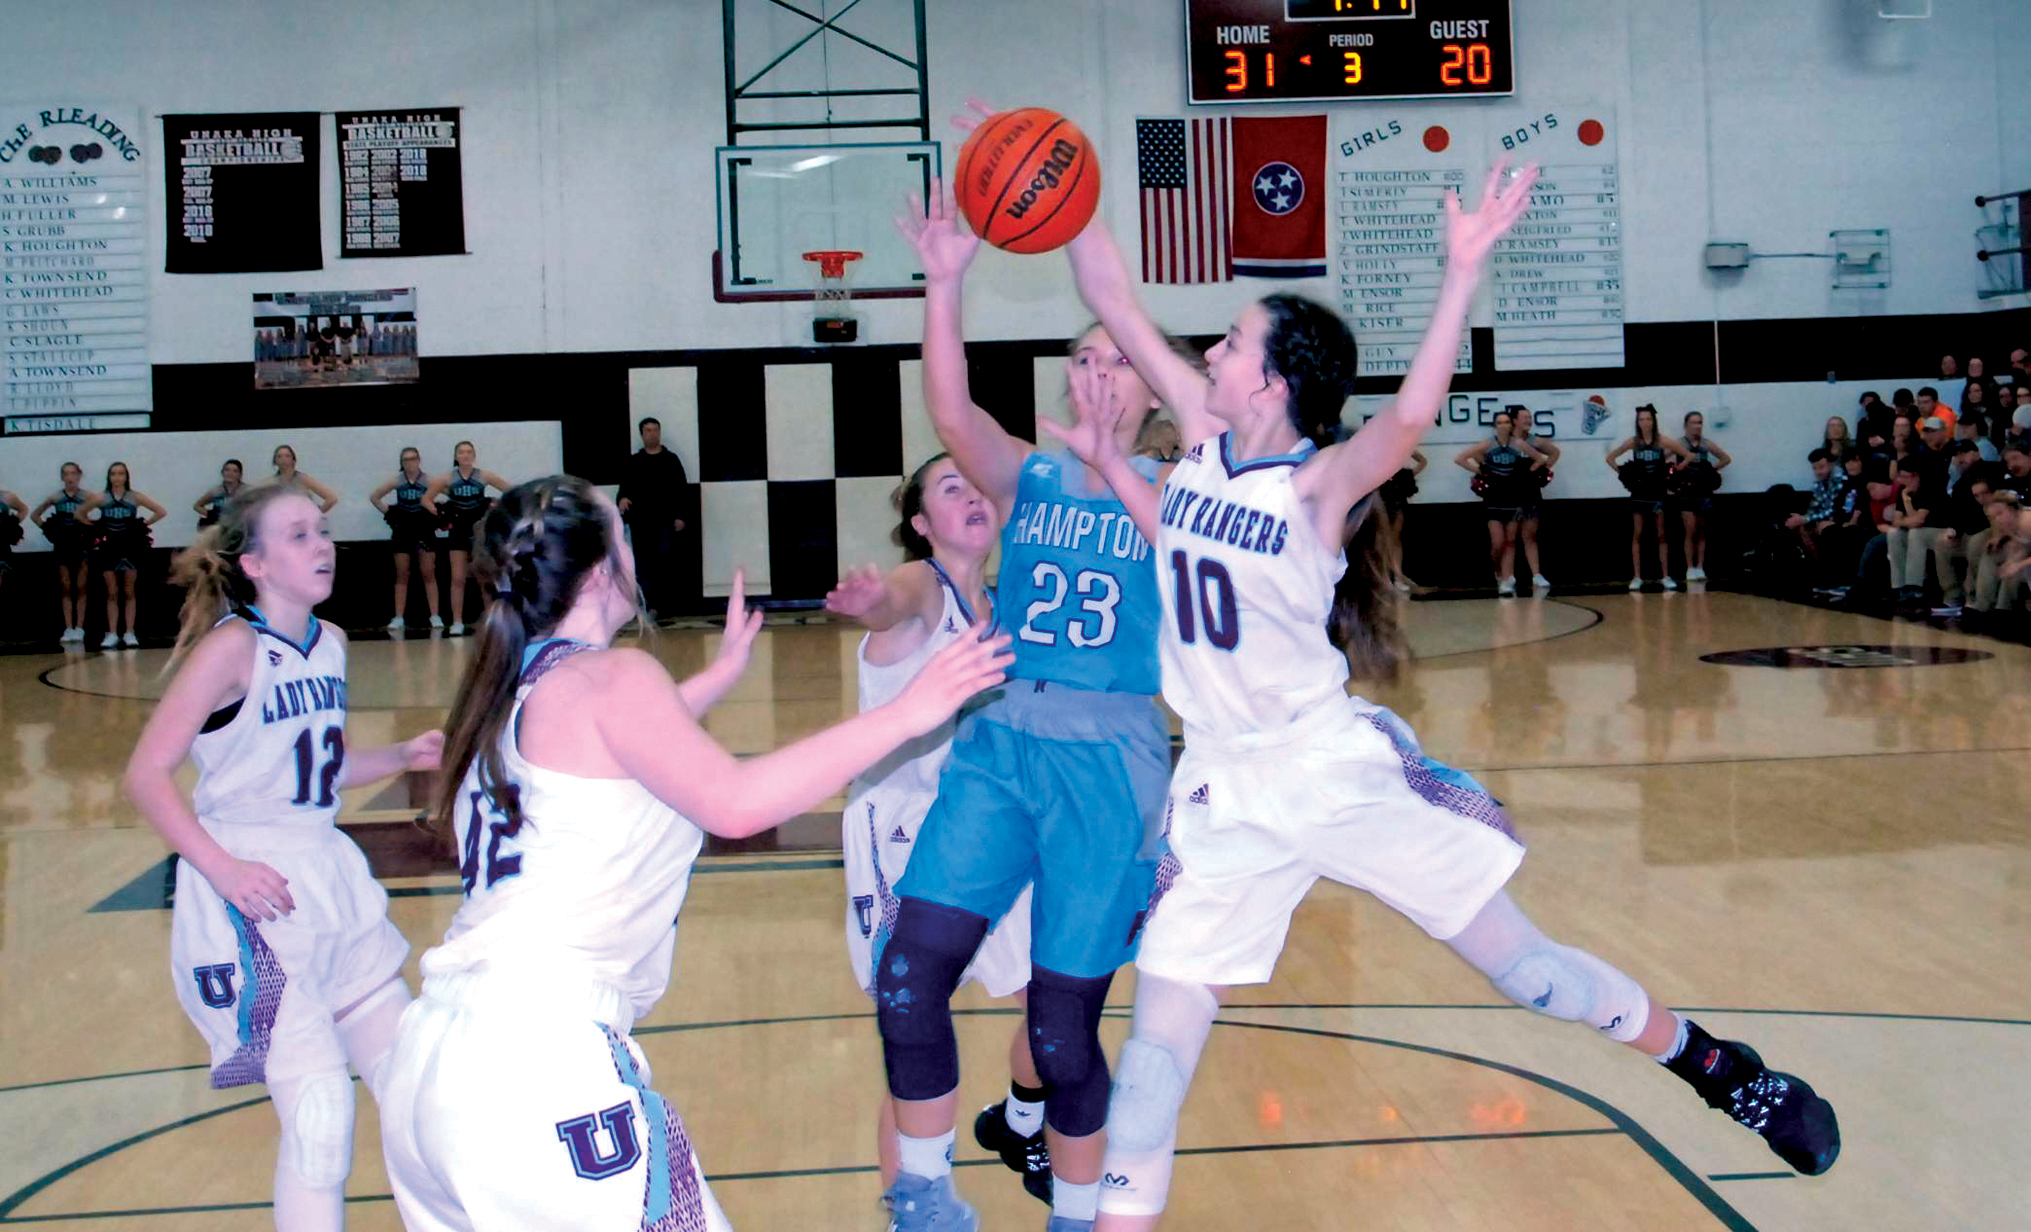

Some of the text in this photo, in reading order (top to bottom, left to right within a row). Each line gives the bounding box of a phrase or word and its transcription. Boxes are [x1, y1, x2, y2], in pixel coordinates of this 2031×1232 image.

[1216, 25, 1271, 45] HOME
[1329, 34, 1374, 47] PERIOD
[1430, 20, 1490, 39] GUEST
[1224, 51, 1275, 91] 31
[1343, 52, 1362, 84] 3
[1440, 44, 1491, 85] 20
[186, 142, 280, 157] BASKETBALL
[348, 125, 435, 141] BASKETBALL
[1340, 120, 1402, 157] GIRLS
[1502, 113, 1558, 150] BOYS
[1005, 139, 1079, 219] Wilson
[1013, 502, 1149, 562] HAMPTON
[1190, 496, 1289, 556] RANGERS
[1018, 560, 1123, 650] 23
[1170, 548, 1240, 652] 10
[262, 679, 308, 724] LADY
[290, 726, 345, 809] 12
[193, 962, 237, 1009] U
[555, 1099, 642, 1182] U
